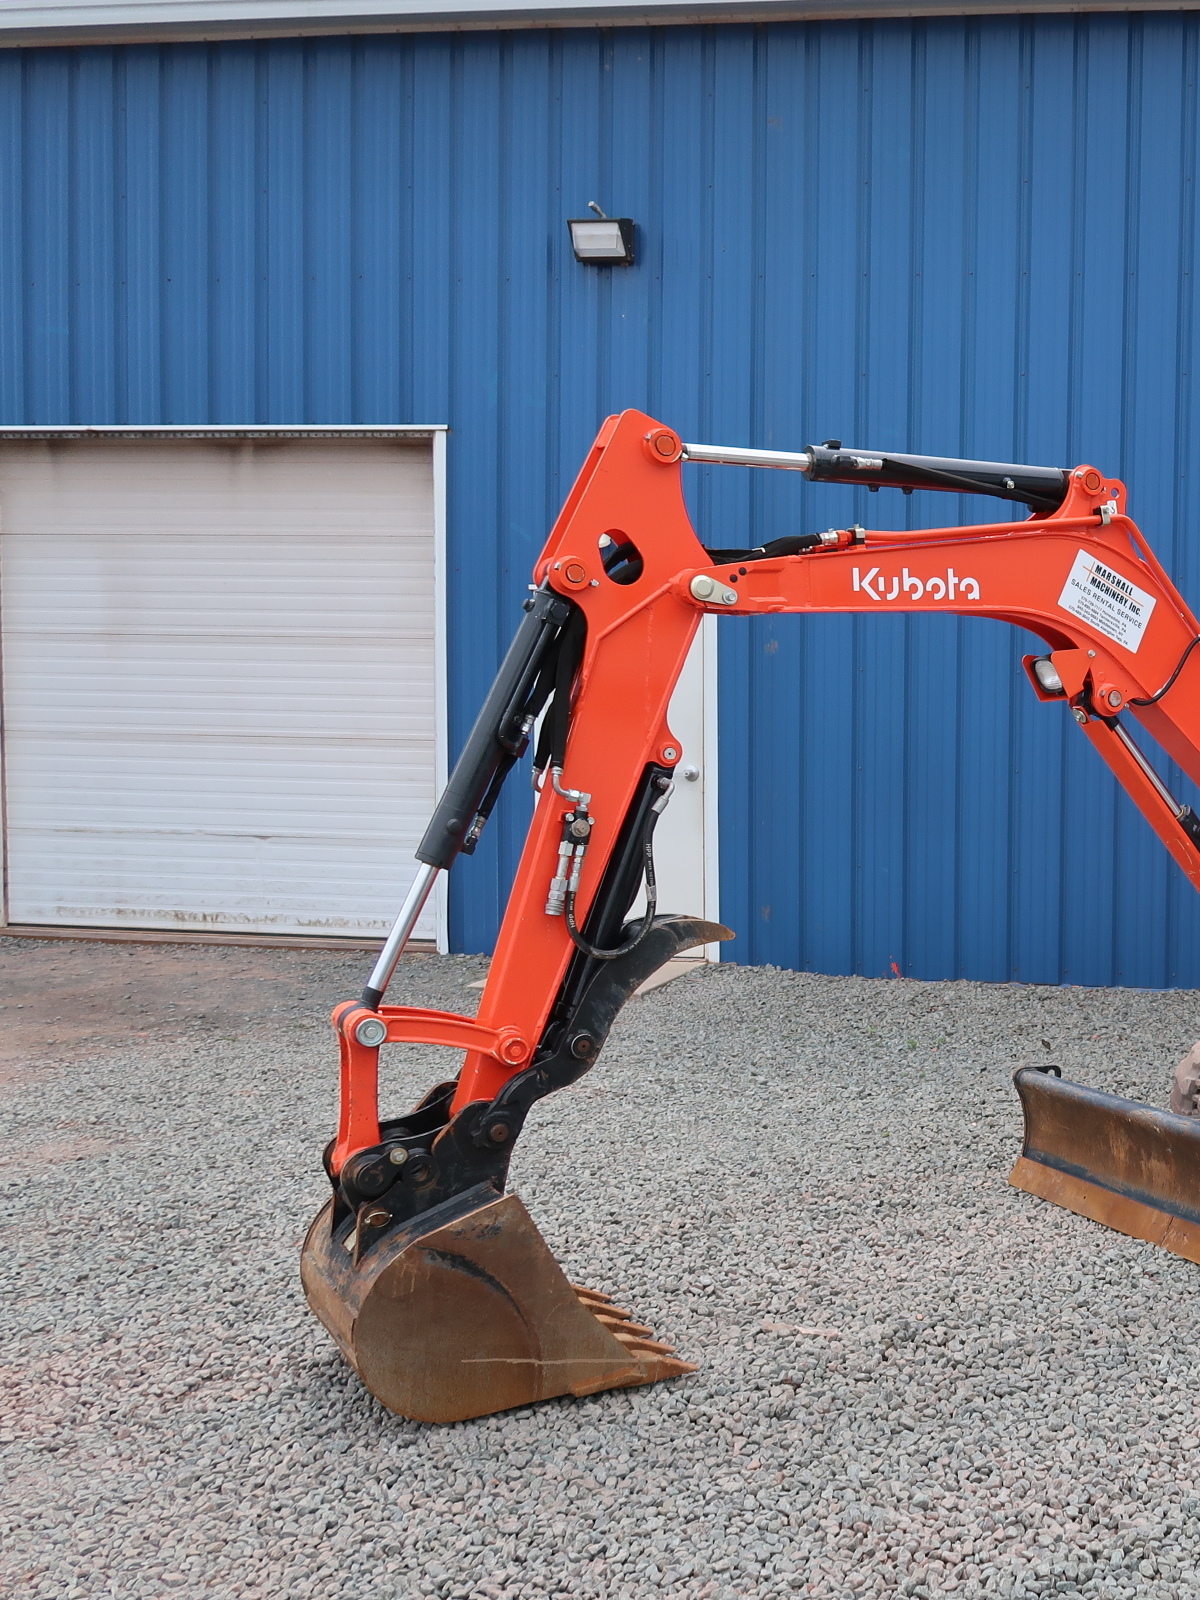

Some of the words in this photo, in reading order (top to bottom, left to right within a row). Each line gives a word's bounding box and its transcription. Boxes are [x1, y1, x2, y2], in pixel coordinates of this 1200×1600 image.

[852, 567, 980, 601] Kubota
[1089, 575, 1129, 608] MACHINERY,
[1128, 601, 1142, 616] Inc.
[1094, 564, 1133, 596] MARSHALL
[1070, 578, 1091, 596] SALES
[1092, 592, 1116, 611] RENTAL
[1116, 608, 1142, 629] SERVICE
